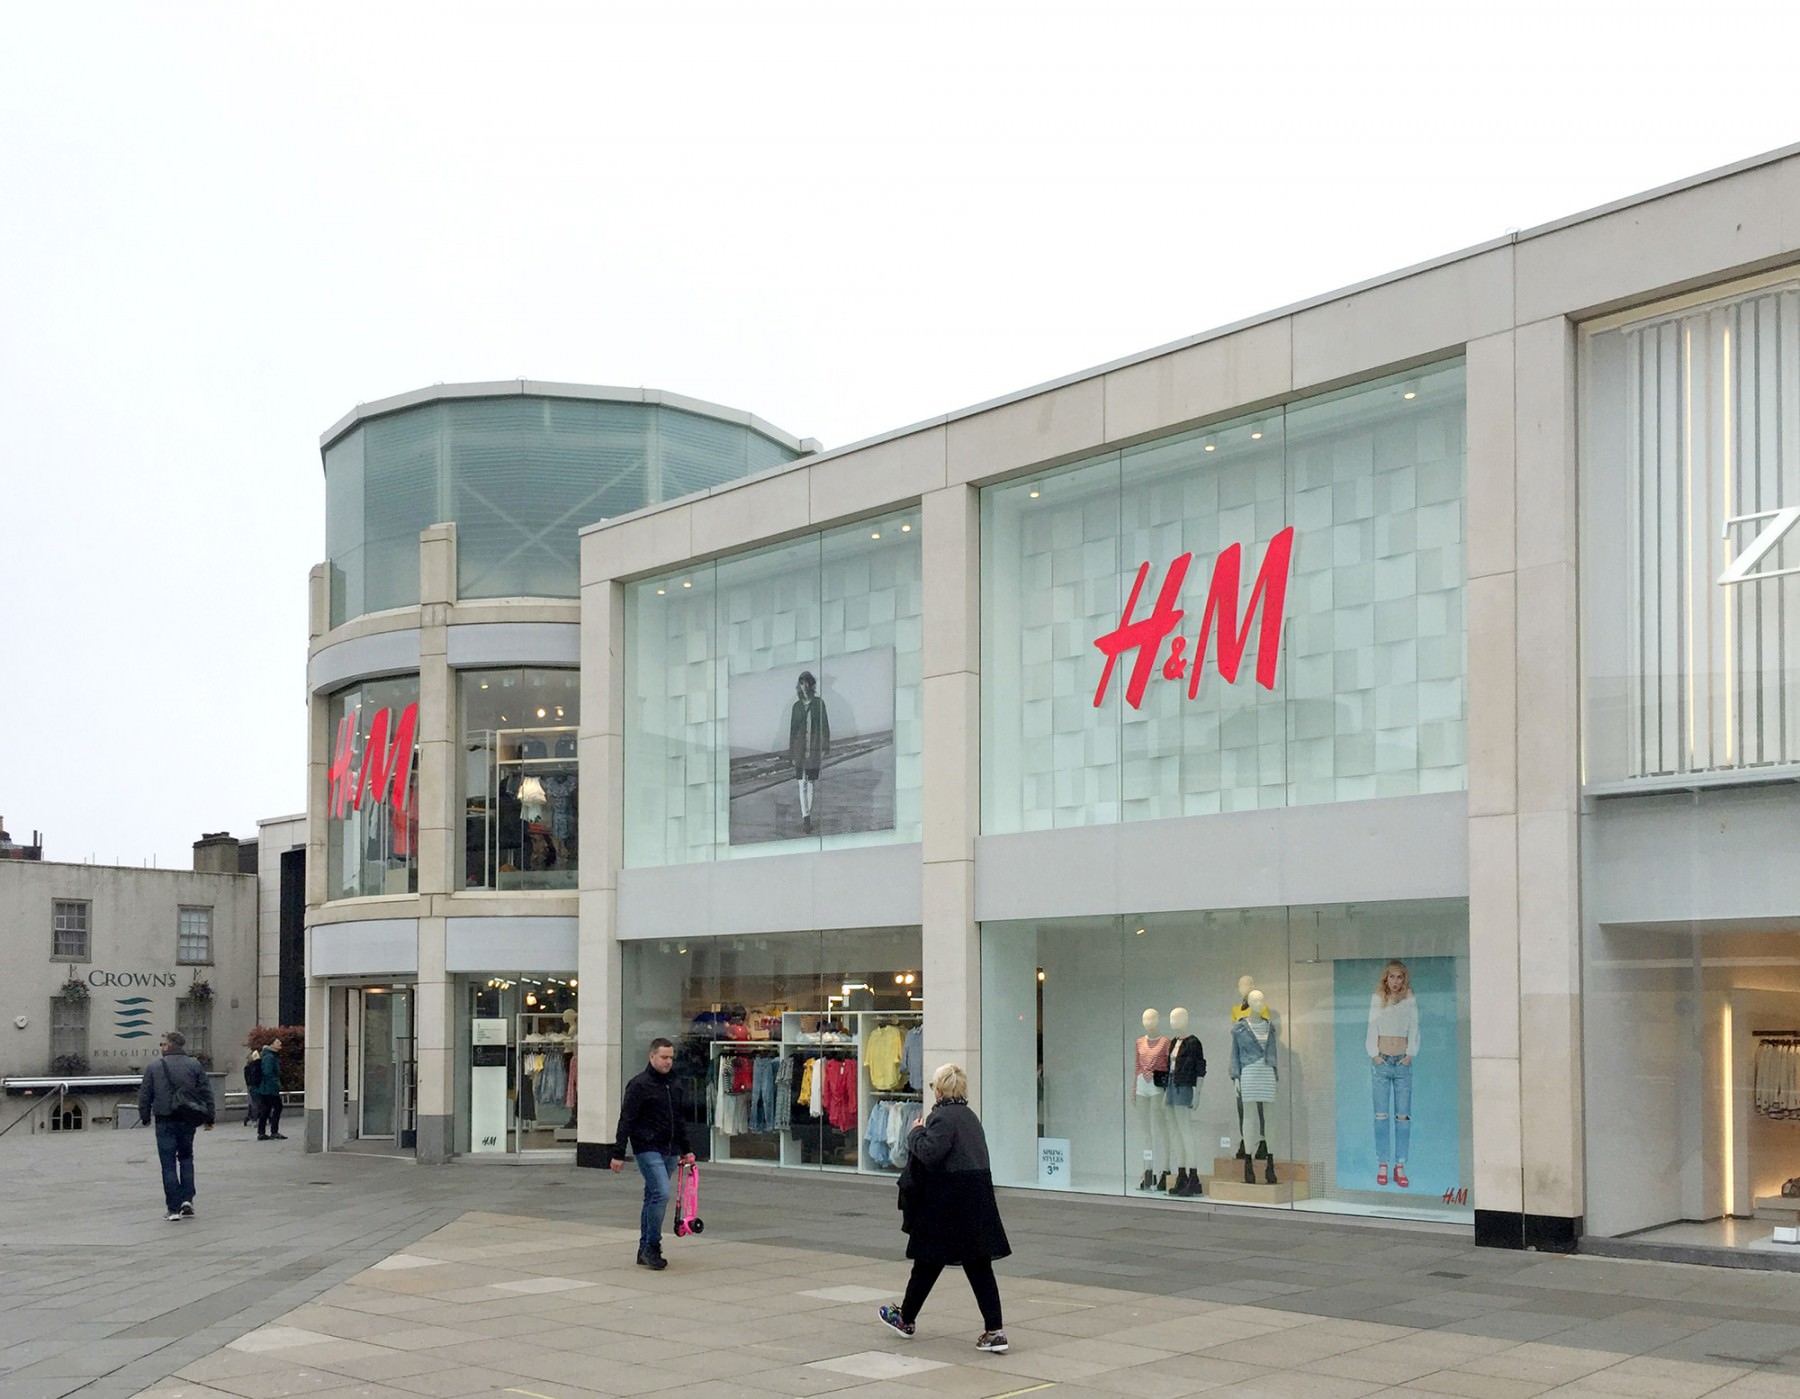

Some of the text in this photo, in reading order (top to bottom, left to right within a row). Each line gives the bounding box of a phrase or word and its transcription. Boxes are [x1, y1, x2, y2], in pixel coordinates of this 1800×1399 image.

[1094, 526, 1294, 710] H&M
[327, 701, 418, 819] H&M
[94, 1049, 160, 1057] BRIGHTO
[1442, 1187, 1468, 1206] H&M
